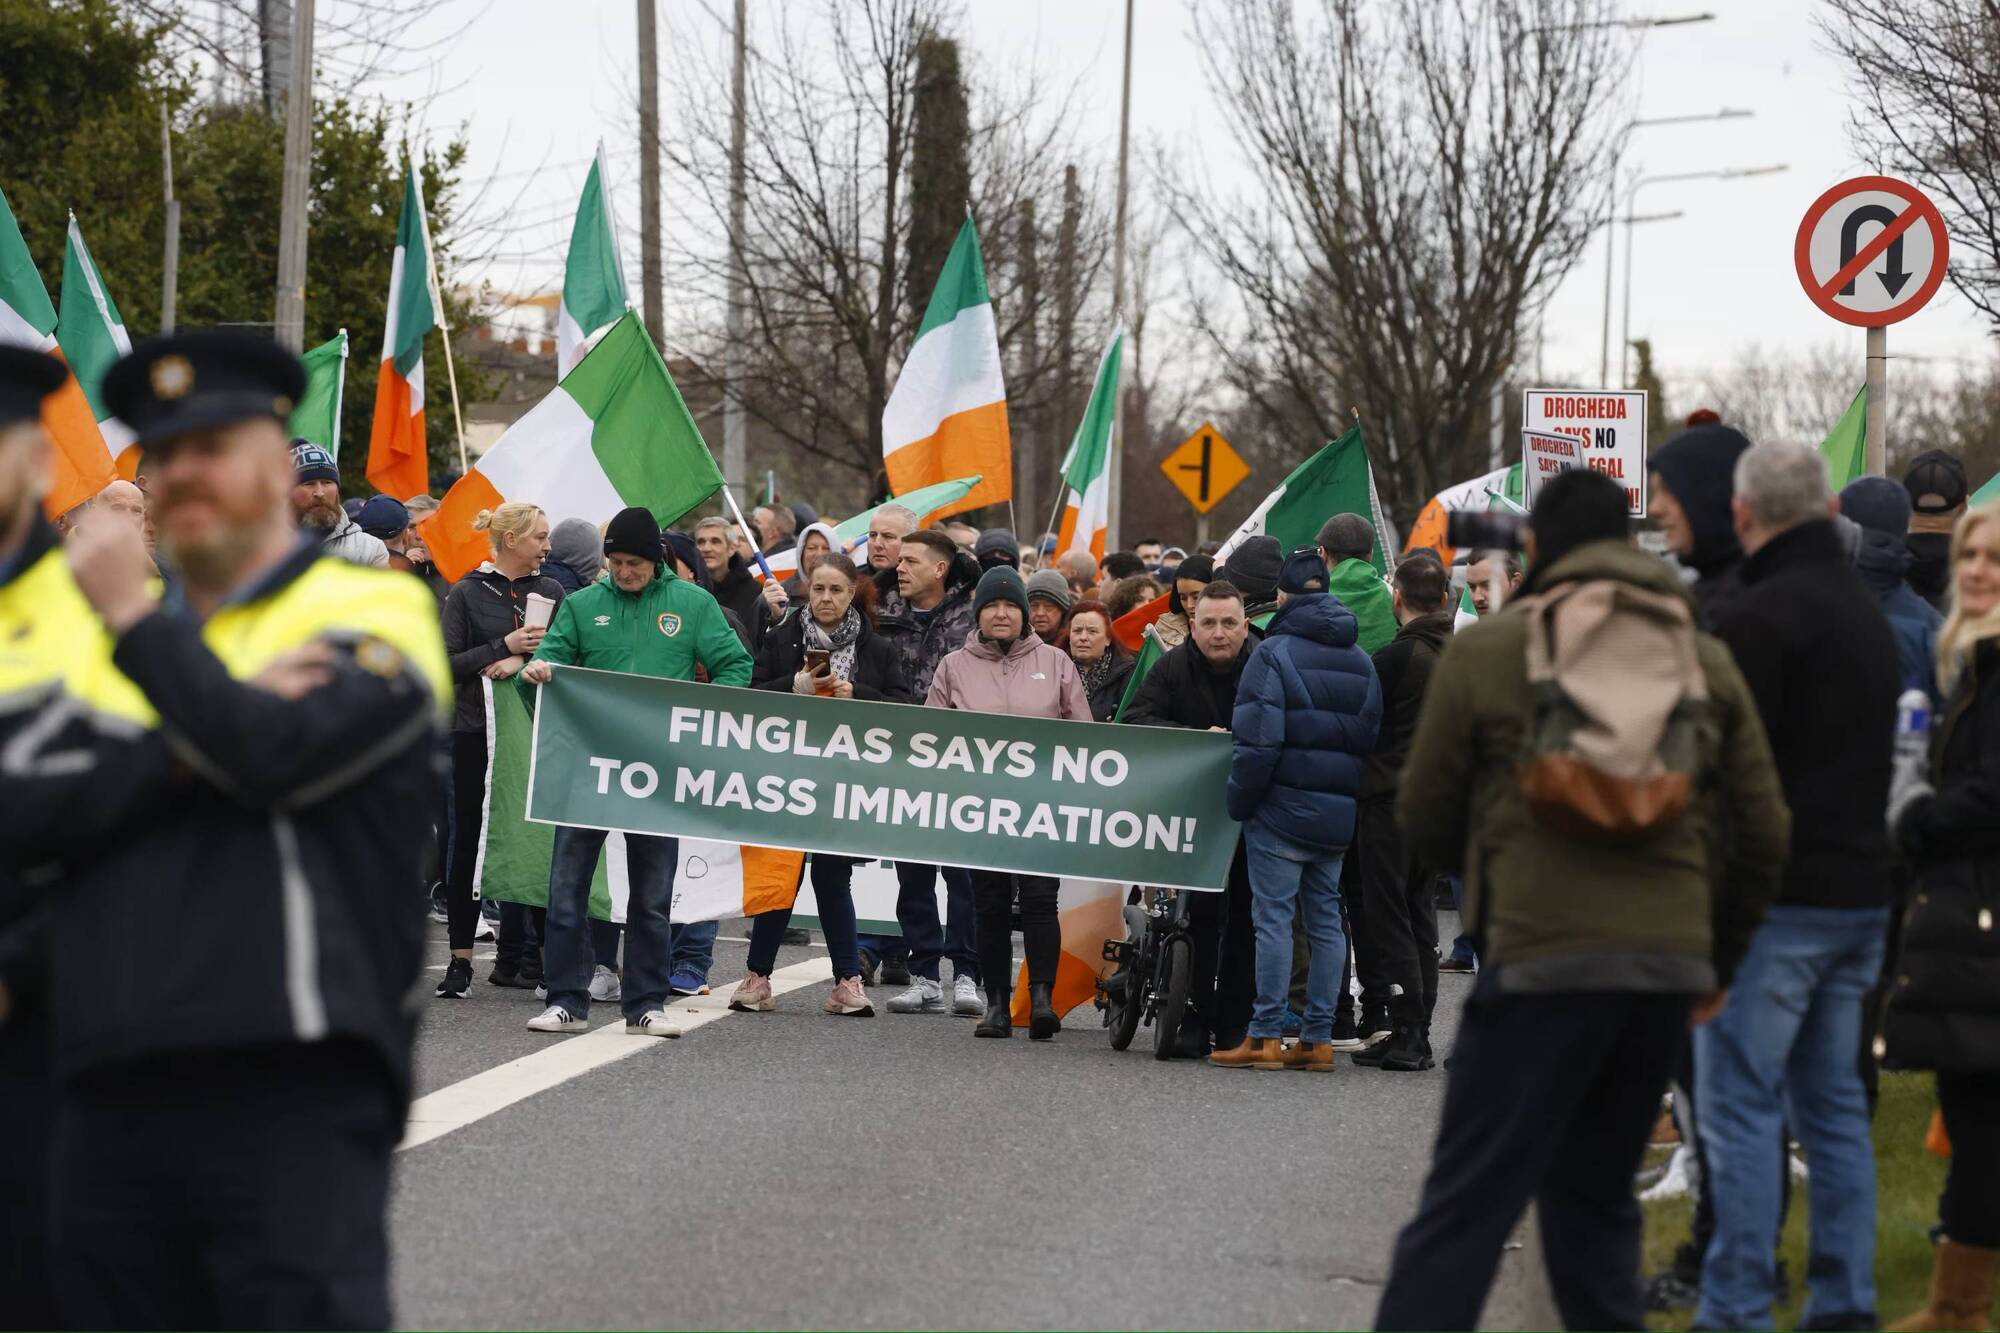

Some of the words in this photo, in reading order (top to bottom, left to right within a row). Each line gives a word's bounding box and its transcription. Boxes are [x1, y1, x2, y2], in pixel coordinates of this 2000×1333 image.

[1544, 397, 1627, 419] DROGHEDA
[1530, 436, 1575, 458] DROGHEDA
[1595, 427, 1616, 449] NO
[1538, 456, 1559, 474] SAYS
[669, 706, 893, 764] FINGLAS
[907, 732, 1036, 778] SAYS
[1051, 745, 1129, 787] NO
[589, 756, 659, 799] TO
[674, 766, 817, 816] MASS
[833, 782, 1197, 854] IMMIGRATION!
